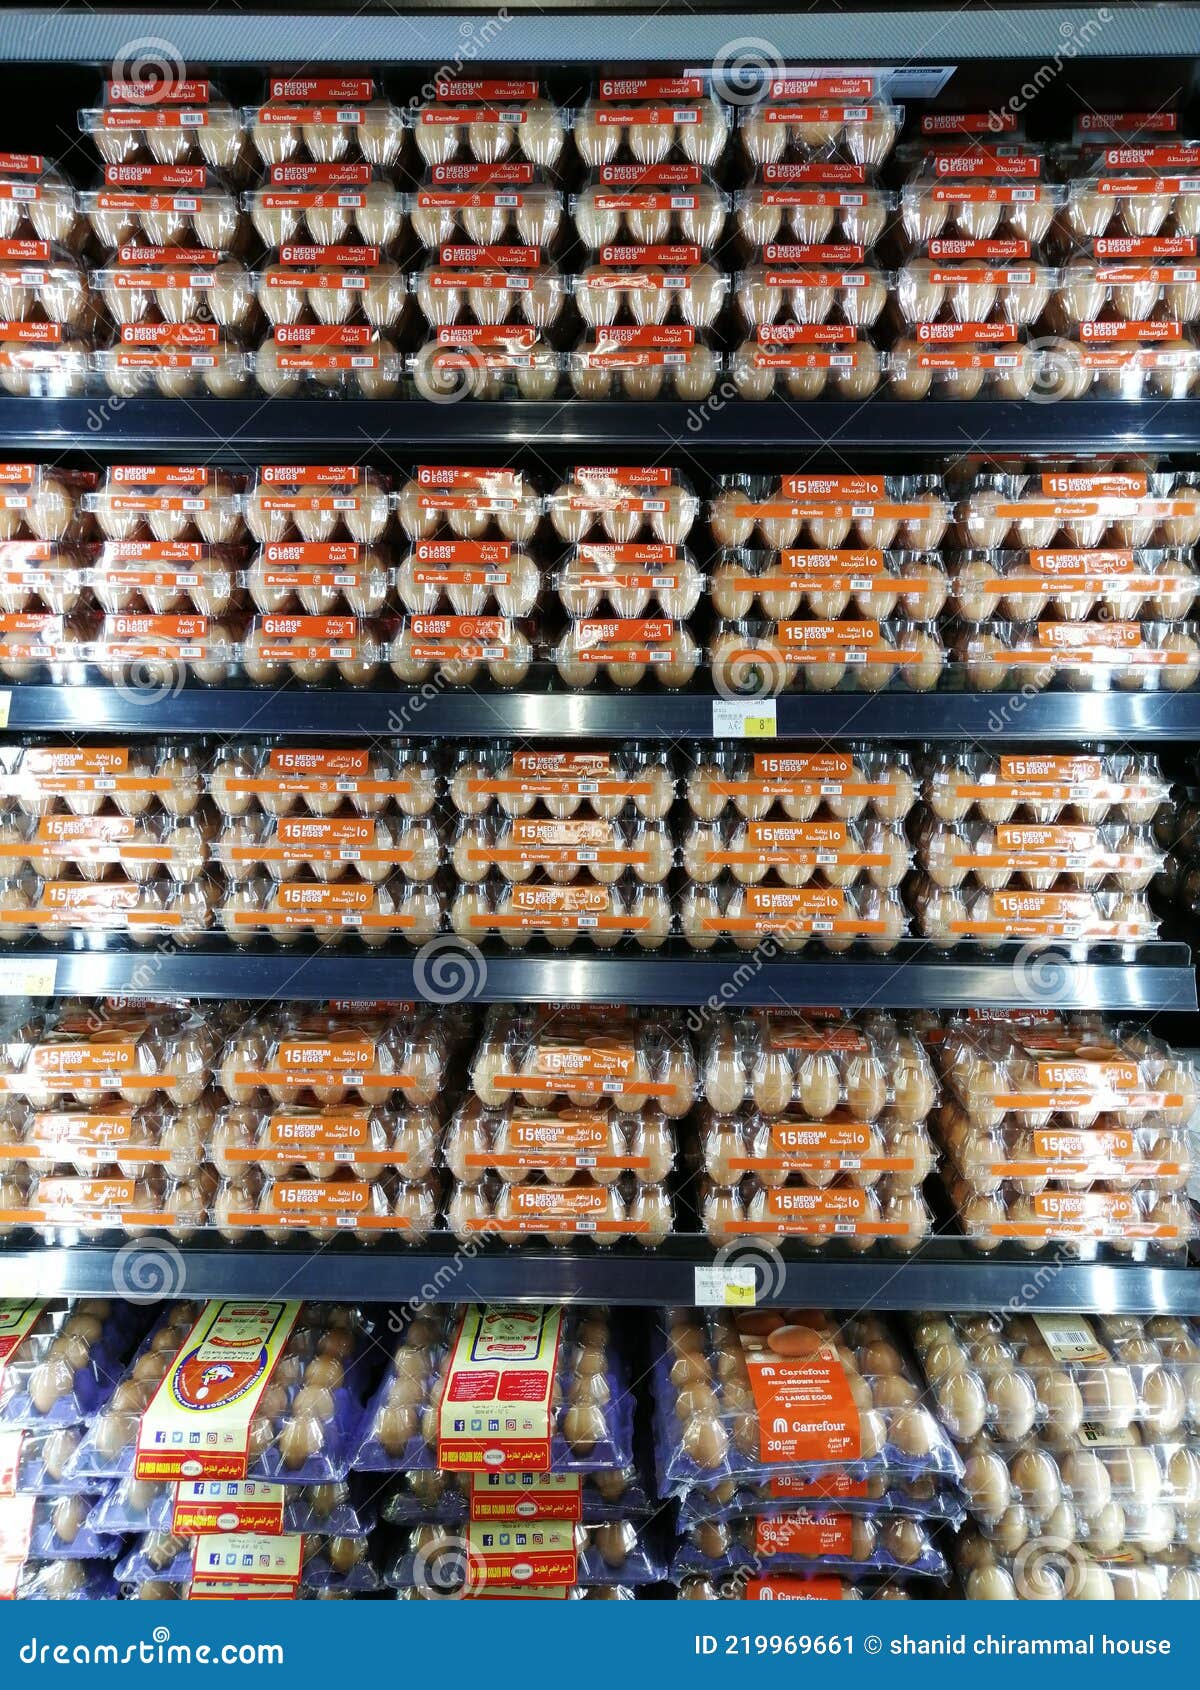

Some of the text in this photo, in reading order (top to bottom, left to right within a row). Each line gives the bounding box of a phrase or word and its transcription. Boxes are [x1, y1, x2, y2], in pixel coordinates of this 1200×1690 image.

[274, 83, 283, 96] 6
[603, 83, 612, 95] 6
[939, 159, 949, 172] 6
[108, 167, 118, 180] 6
[603, 167, 613, 179] 6
[1097, 239, 1106, 252] 6
[443, 249, 452, 261] 6
[277, 328, 287, 341] 6
[920, 326, 929, 338] 6
[114, 468, 124, 480] 6
[789, 481, 806, 493] 15
[268, 547, 278, 560] 6
[419, 546, 428, 558] 6
[789, 555, 806, 567] 15
[265, 620, 274, 633] 6
[284, 826, 301, 837] 15
[284, 891, 300, 902] 15
[754, 894, 771, 906] 15
[1000, 899, 1018, 910] 15
[285, 1050, 301, 1062] 15
[779, 1132, 797, 1144] 15
[280, 1190, 296, 1202] 15
[775, 1196, 792, 1208] 15
[792, 1421, 845, 1432] Carrefour
[768, 1441, 781, 1450] 30
[778, 1477, 791, 1486] 30
[763, 1531, 776, 1540] 30
